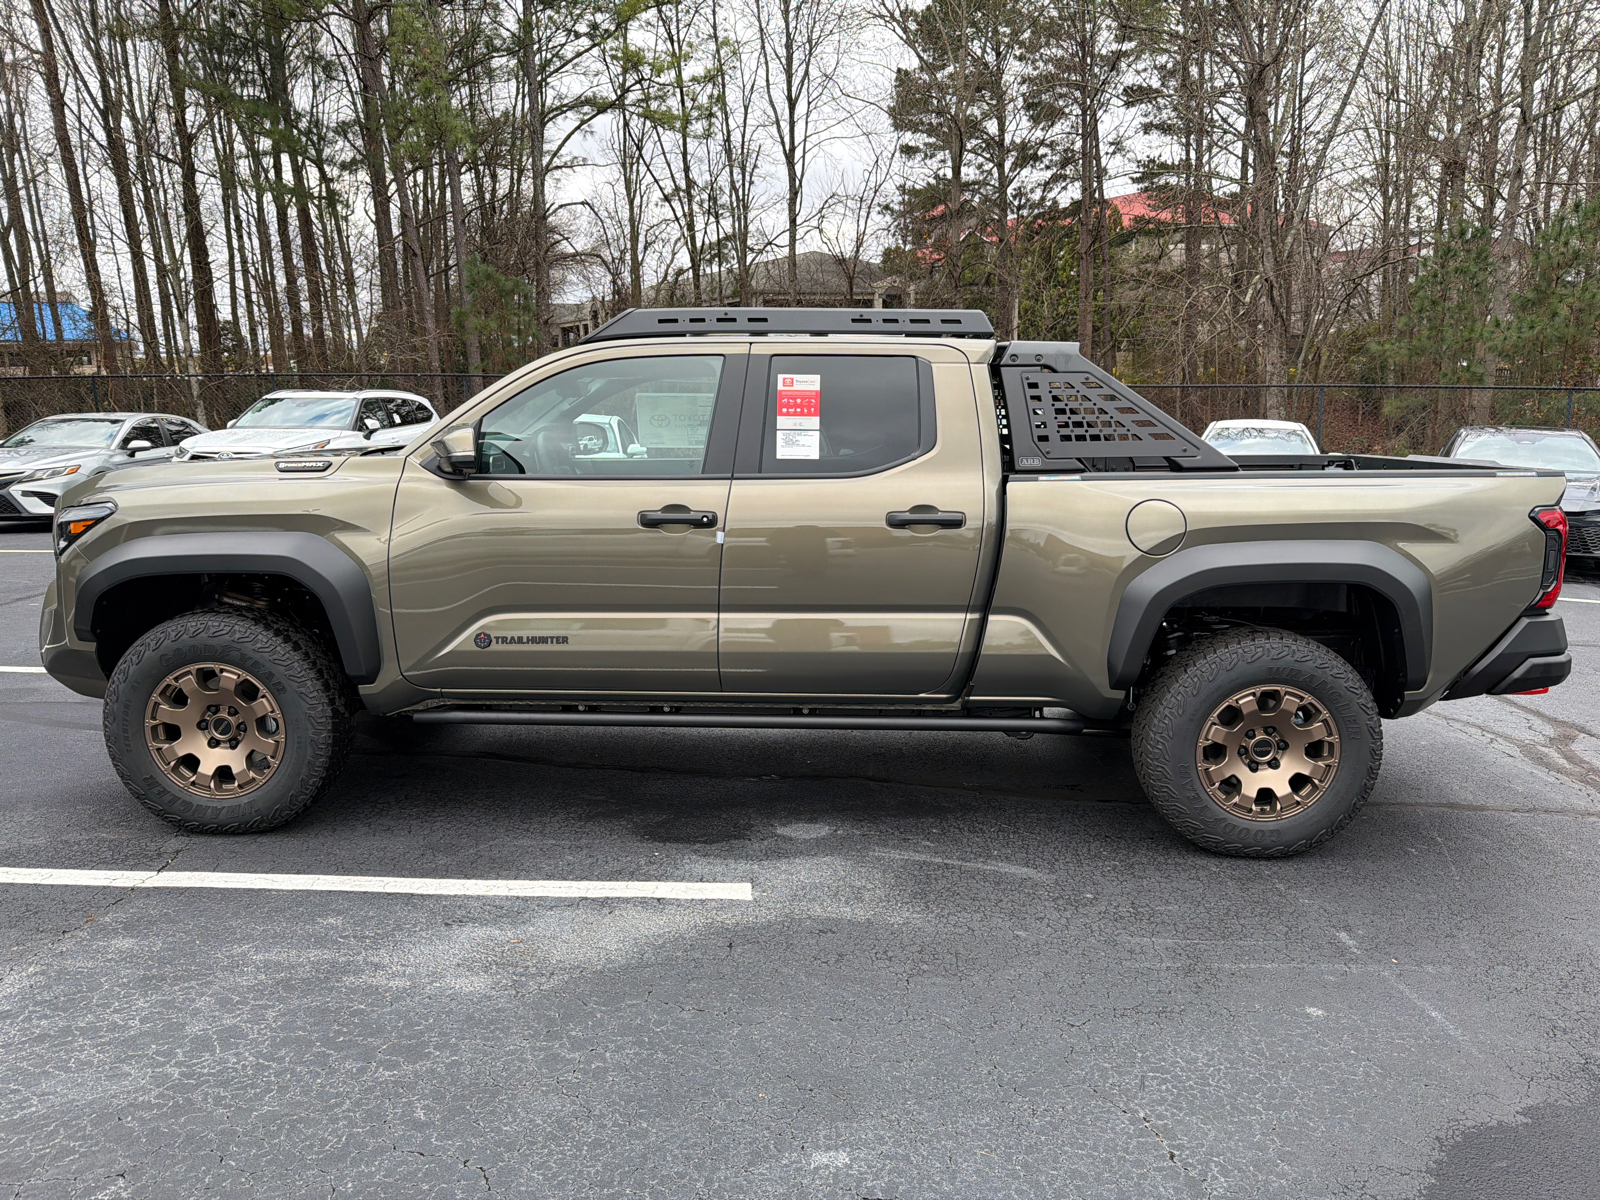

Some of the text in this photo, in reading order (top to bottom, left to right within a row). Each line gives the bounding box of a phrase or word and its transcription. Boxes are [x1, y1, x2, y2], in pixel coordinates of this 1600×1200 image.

[672, 413, 709, 422] TOYOT
[493, 636, 569, 645] TRAILHUNTER
[1265, 664, 1363, 741] WRANGLER
